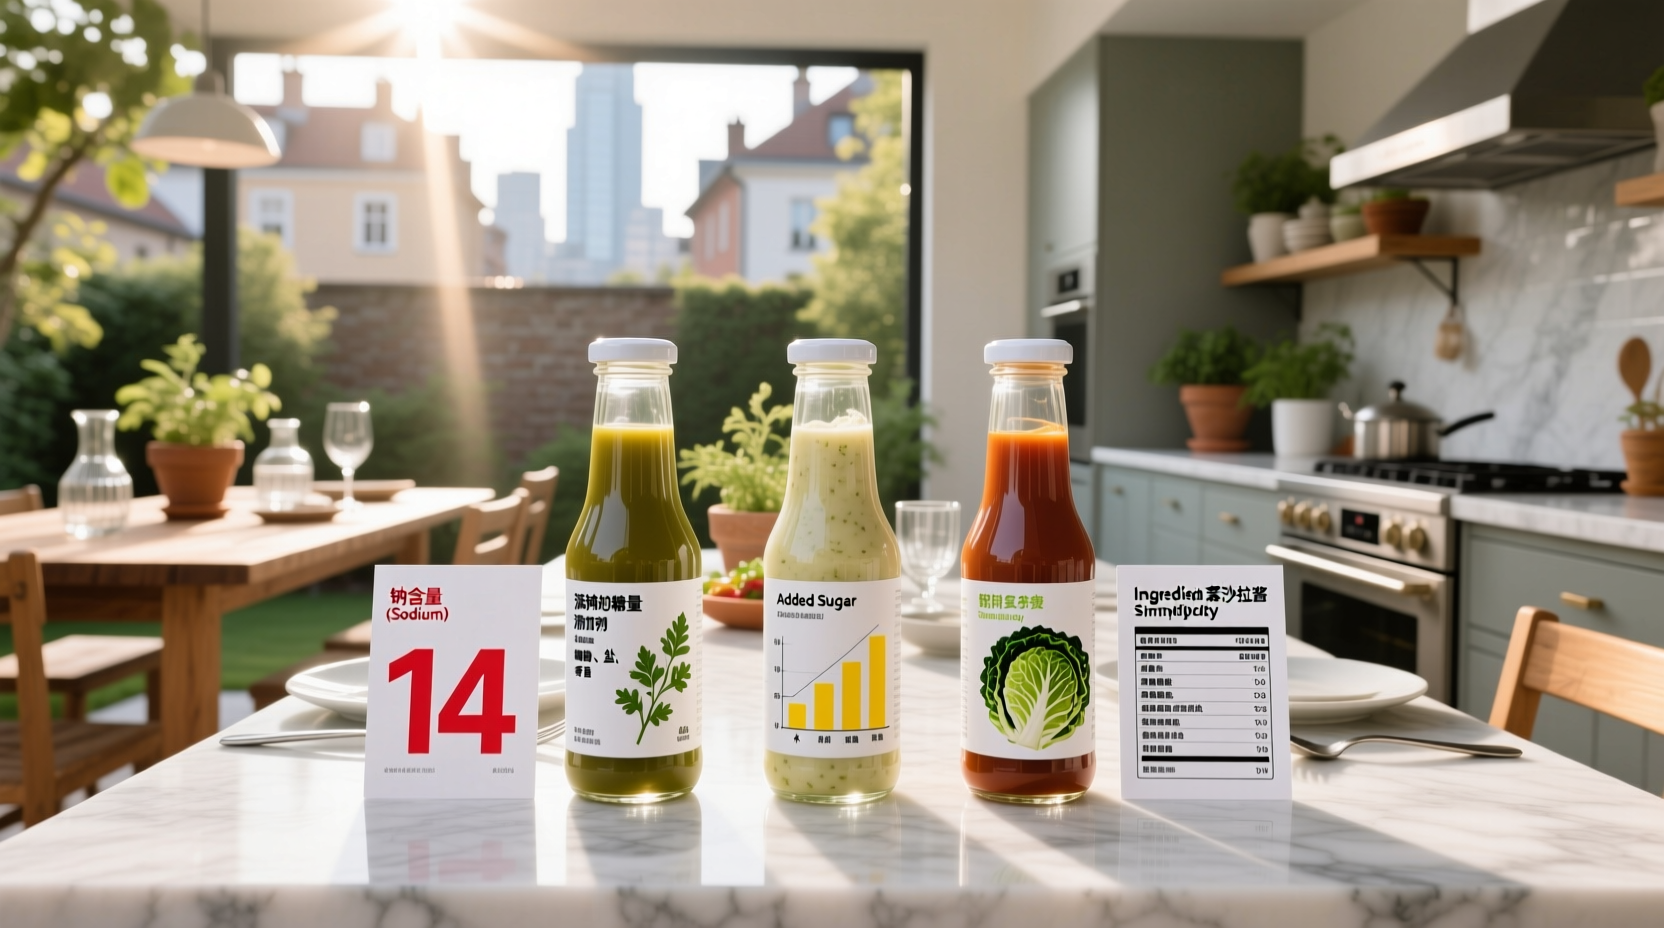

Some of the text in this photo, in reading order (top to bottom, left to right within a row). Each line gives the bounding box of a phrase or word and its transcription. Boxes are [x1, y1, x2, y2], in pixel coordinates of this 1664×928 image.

[390, 586, 442, 605] 钠含量
[777, 593, 857, 611] Added Sugar
[386, 607, 449, 622] (Sodium)
[388, 648, 516, 754] 14
